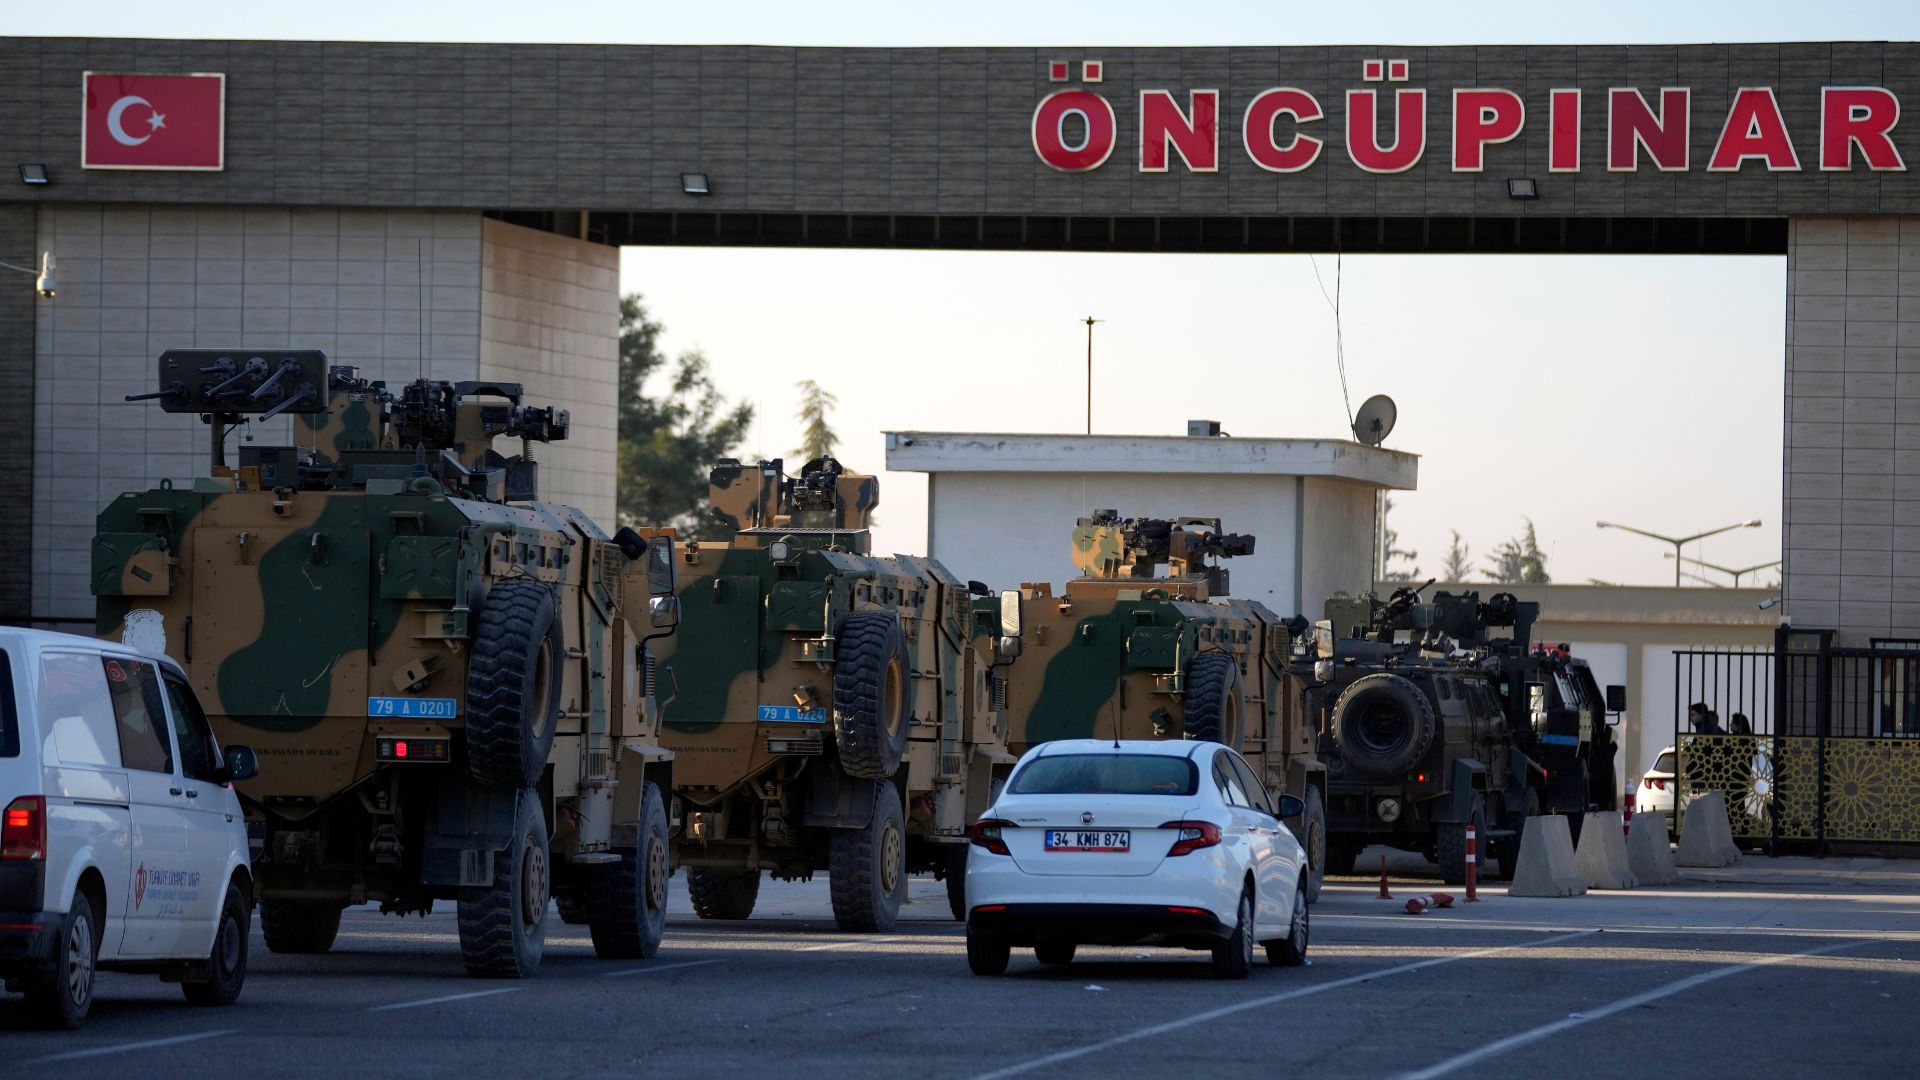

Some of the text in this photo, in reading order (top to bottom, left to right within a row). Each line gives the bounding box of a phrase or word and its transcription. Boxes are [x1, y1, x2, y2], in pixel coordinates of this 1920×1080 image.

[1031, 58, 1907, 174] ÖNCÜPINAR
[376, 699, 451, 716] 79 A 0201
[764, 707, 778, 719] 79
[784, 708, 790, 720] A
[255, 747, 304, 756] RKASINDA
[1054, 832, 1069, 846] 34
[1077, 832, 1100, 847] KMH
[1104, 833, 1127, 847] 874
